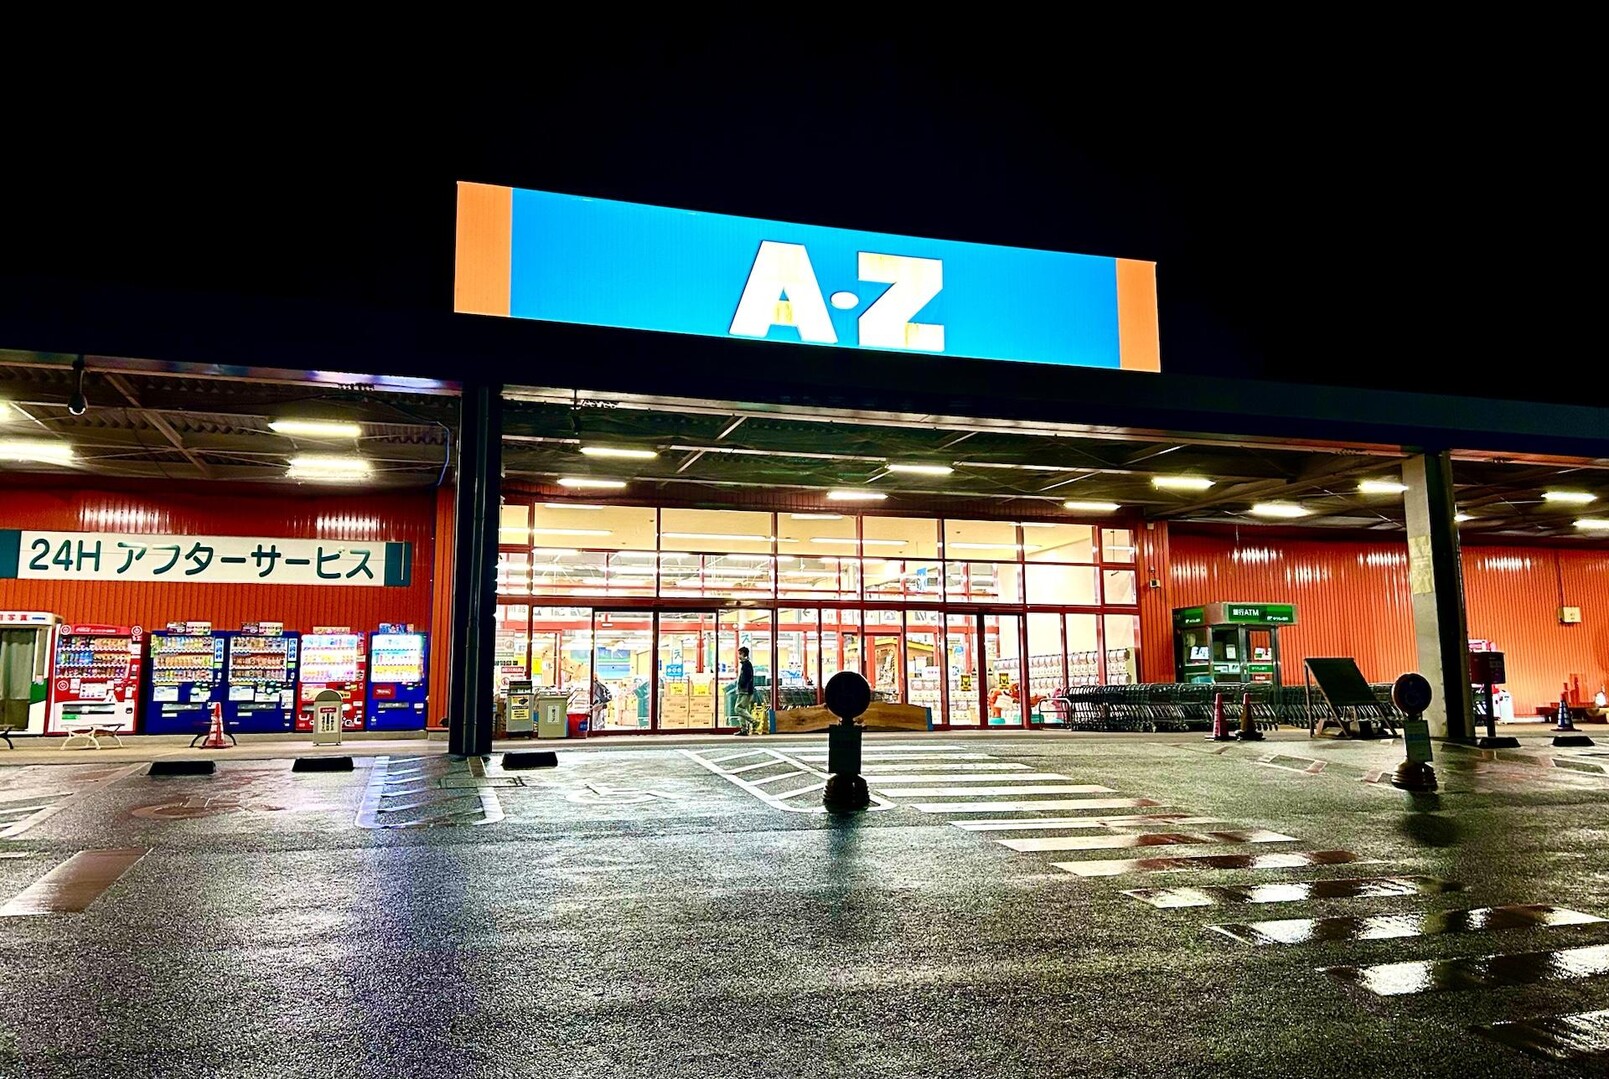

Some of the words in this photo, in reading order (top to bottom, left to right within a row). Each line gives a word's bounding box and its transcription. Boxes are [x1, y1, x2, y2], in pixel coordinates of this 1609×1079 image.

[29, 538, 100, 572] 24H
[117, 541, 374, 580] アフターサービス
